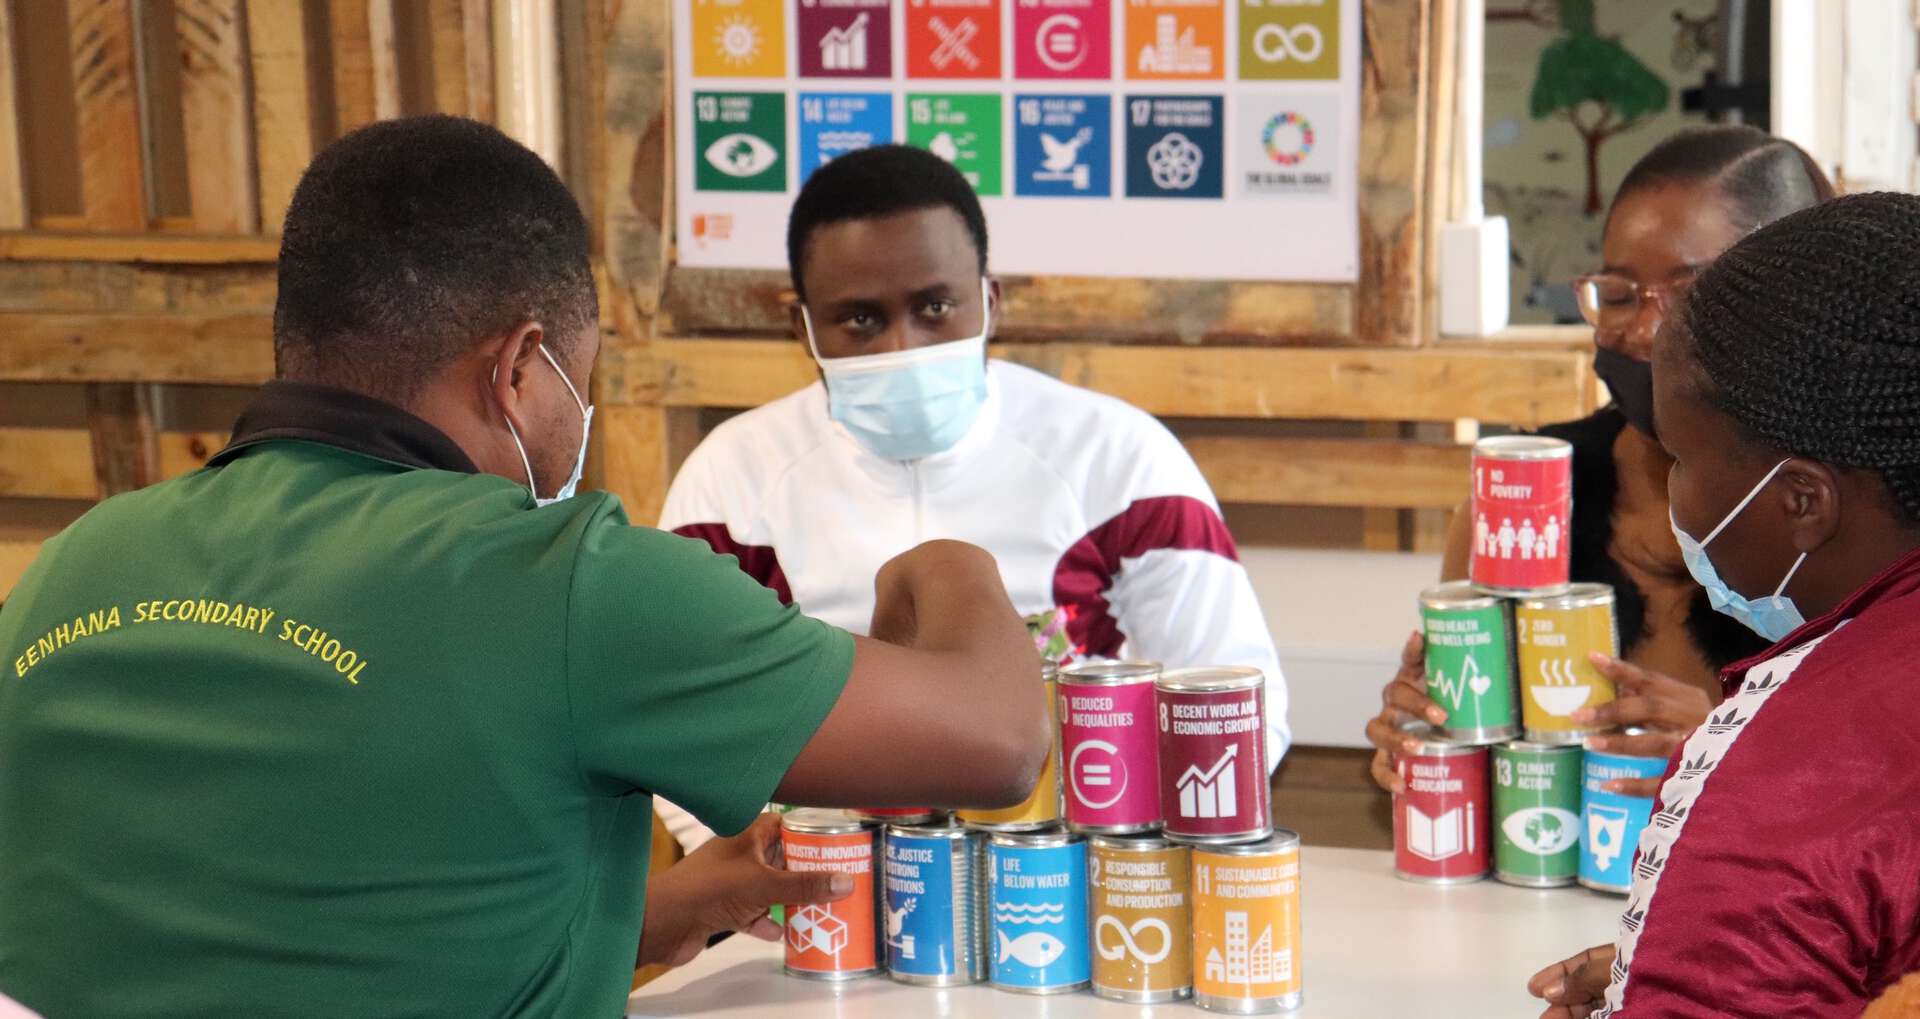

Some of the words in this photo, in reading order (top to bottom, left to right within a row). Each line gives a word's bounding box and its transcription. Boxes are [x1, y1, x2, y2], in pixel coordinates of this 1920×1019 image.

[698, 97, 718, 122] 13
[802, 98, 822, 122] 14
[911, 99, 931, 124] 15
[1131, 100, 1151, 126] 17
[1490, 469, 1504, 483] NO
[1490, 484, 1532, 499] POVERTY
[1519, 617, 1527, 645] 2
[15, 606, 121, 678] EENHANA
[133, 599, 274, 634] SECONDARY
[278, 619, 367, 685] SCHOOL
[1071, 696, 1113, 711] REDUCED
[1172, 703, 1208, 719] DECENT
[1209, 702, 1239, 719] WORK
[1240, 699, 1257, 715] AND
[1072, 712, 1134, 728] INEQUALITIES
[1159, 702, 1169, 732] 8
[1173, 720, 1223, 735] ECONOMIC
[1224, 716, 1260, 734] GROWTH
[1411, 763, 1450, 778] QUALITY
[1495, 757, 1512, 787] 13
[1517, 761, 1555, 776] CLIMATE
[1411, 778, 1463, 793] EDUCATION
[1517, 776, 1552, 791] ACTION
[897, 847, 933, 863] JUSTICE
[1003, 856, 1021, 873] LIFE
[1105, 861, 1167, 876] RESPONSIBLE
[1003, 873, 1035, 889] BELOW
[1037, 872, 1070, 889] WATER
[1105, 877, 1172, 893] CONSUMPTION
[1216, 883, 1236, 897] AND
[1124, 893, 1184, 909] PRODUCTION
